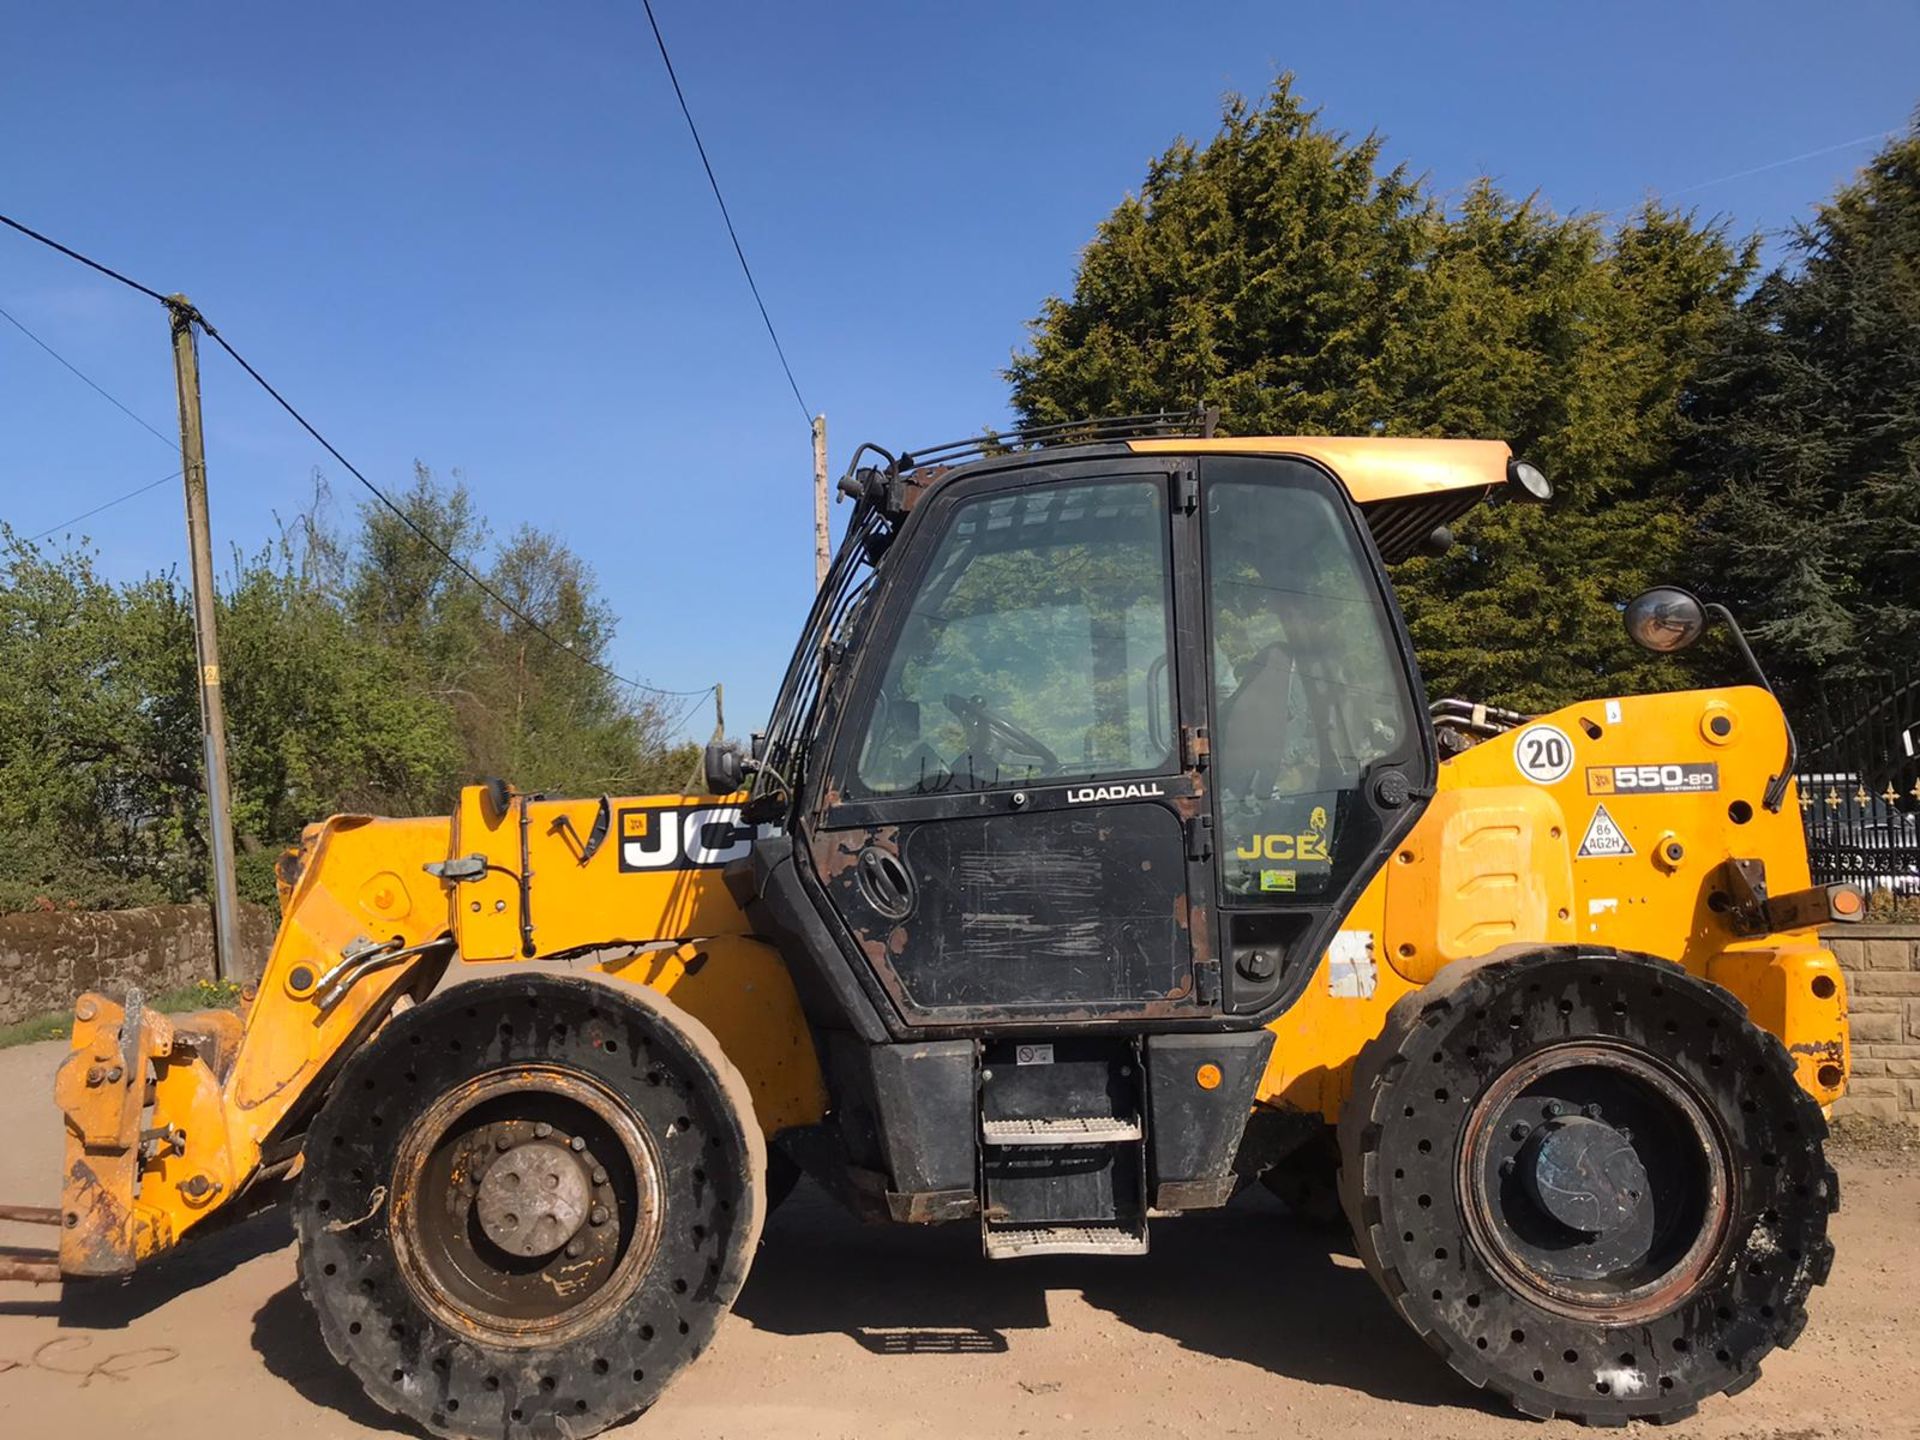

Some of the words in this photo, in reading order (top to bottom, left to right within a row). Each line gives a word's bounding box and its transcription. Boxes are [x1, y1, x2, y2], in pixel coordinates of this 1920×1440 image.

[1527, 738, 1564, 769] 20
[1615, 765, 1713, 788] 550-80
[1067, 783, 1165, 804] LOADALL
[1596, 825, 1612, 836] 86
[1590, 837, 1620, 849] AG2H
